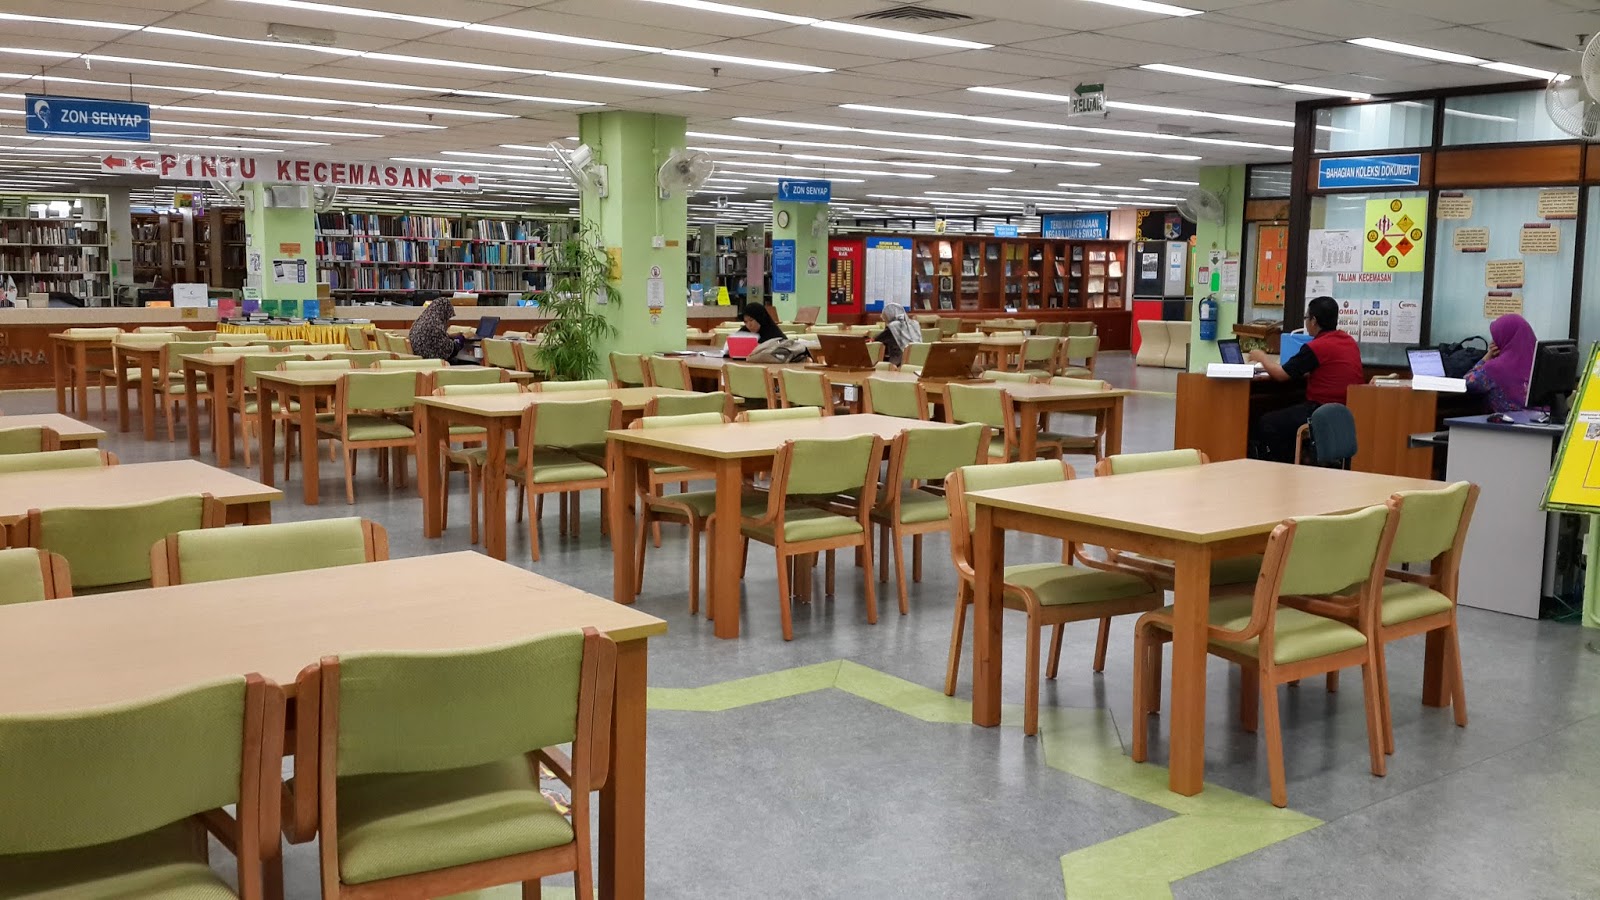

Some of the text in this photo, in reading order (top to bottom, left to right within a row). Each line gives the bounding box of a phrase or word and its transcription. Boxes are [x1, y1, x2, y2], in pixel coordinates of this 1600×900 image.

[1073, 96, 1102, 113] KELUAR
[61, 109, 142, 128] ZON SENYAP
[160, 154, 432, 188] PINTU KECEMASAN
[1326, 164, 1412, 179] BAHAGIAN KOLEKSI DOKUMEN
[793, 186, 828, 195] ZON SENYAP
[1073, 219, 1099, 228] KERAJAAN
[1082, 229, 1102, 237] SWASTA
[1338, 273, 1392, 282] TALIAN KECEMASAN
